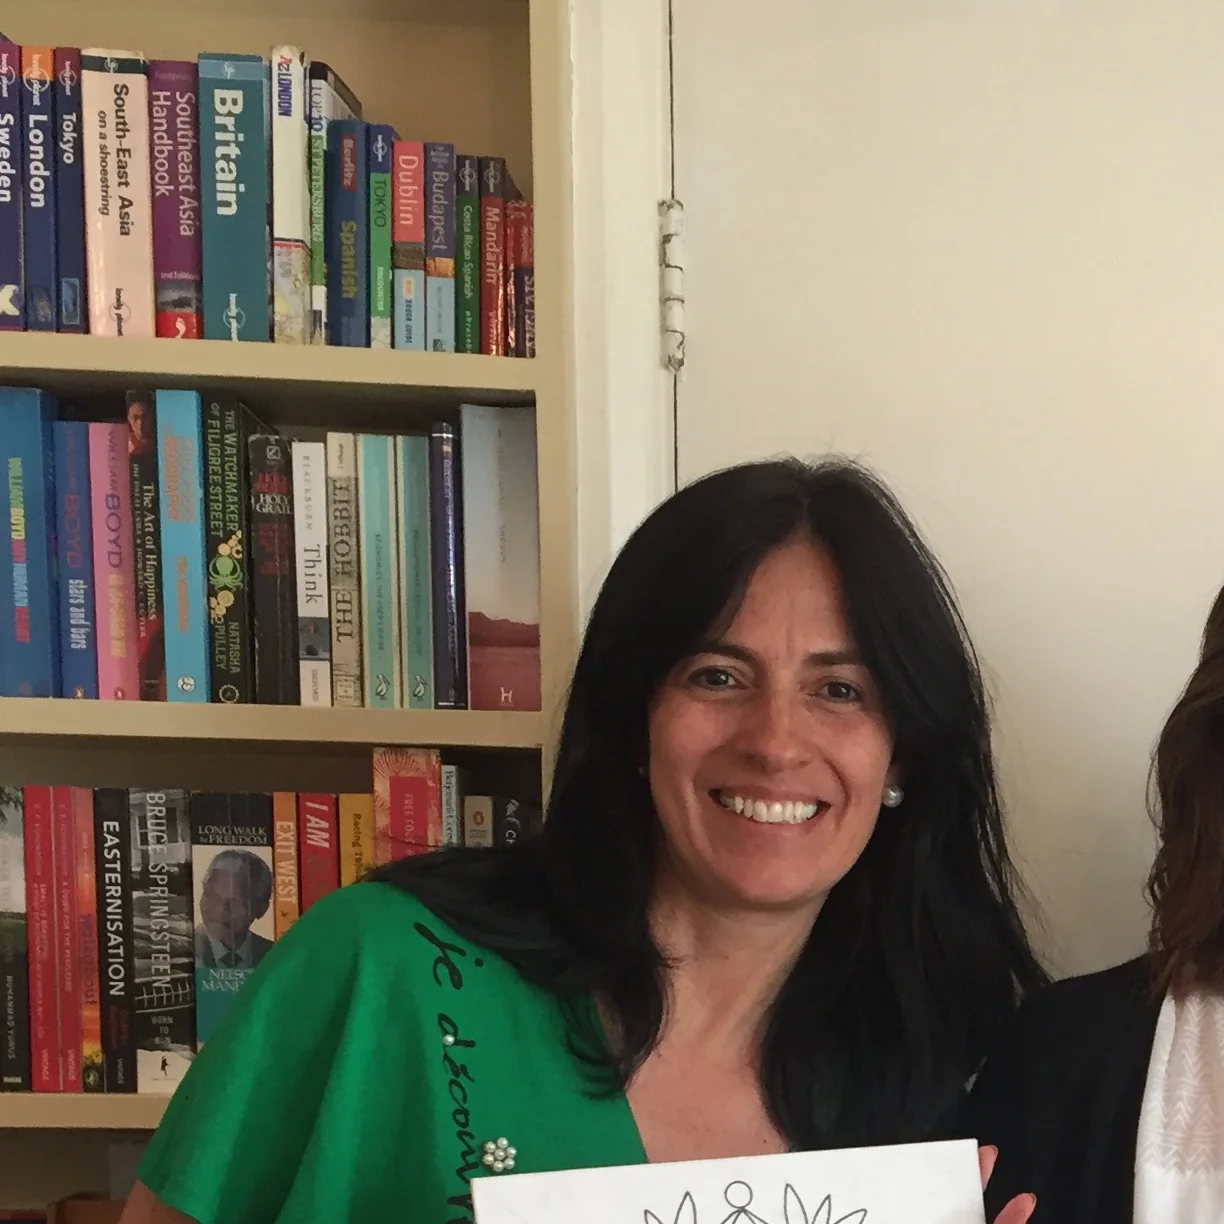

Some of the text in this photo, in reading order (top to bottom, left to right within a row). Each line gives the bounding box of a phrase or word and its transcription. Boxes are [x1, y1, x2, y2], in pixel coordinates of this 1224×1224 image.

[97, 110, 107, 127] on
[277, 72, 293, 117] LONDON
[311, 115, 324, 132] 10
[0, 113, 16, 202] Sweden
[28, 115, 51, 208] London
[60, 113, 77, 164] Tokyo
[113, 83, 134, 236] South-East Asia
[152, 91, 175, 197] Handbook
[176, 91, 199, 237] Southeast Asia
[213, 89, 246, 216] Britain
[97, 143, 110, 216] shoestring
[311, 153, 325, 241] PETERSBURG
[373, 179, 387, 227] TOKYO
[398, 154, 419, 225] Dublin
[427, 171, 449, 251] Budapest
[463, 204, 473, 232] Costa
[484, 207, 500, 285] Mandarin
[341, 221, 358, 298] Spanish
[463, 262, 474, 299] Spanish
[208, 402, 223, 537] OF FILIGREE STREET
[224, 410, 239, 531] THE WATCHMAKER
[258, 493, 290, 504] HOLY
[301, 455, 314, 531] BLACKBURN
[10, 507, 25, 540] BOYD
[64, 494, 82, 569] BOYD
[105, 493, 122, 569] BOYD
[256, 502, 292, 515] GRAIL
[334, 478, 353, 579] HOBBIT
[142, 483, 158, 620] The Art of Happiness
[303, 543, 323, 604] Think
[68, 579, 89, 650] stars and bars
[228, 621, 240, 674] NATASHA
[335, 591, 353, 642] THE
[198, 825, 267, 837] LONG WALK
[208, 835, 268, 845] FREEDOM
[275, 820, 298, 904] EXIT WEST
[305, 814, 330, 849] AM
[352, 813, 363, 848] Racing
[102, 821, 125, 996] EASTERNISATION
[146, 793, 171, 989] BRUCE SPRINGSTEEN
